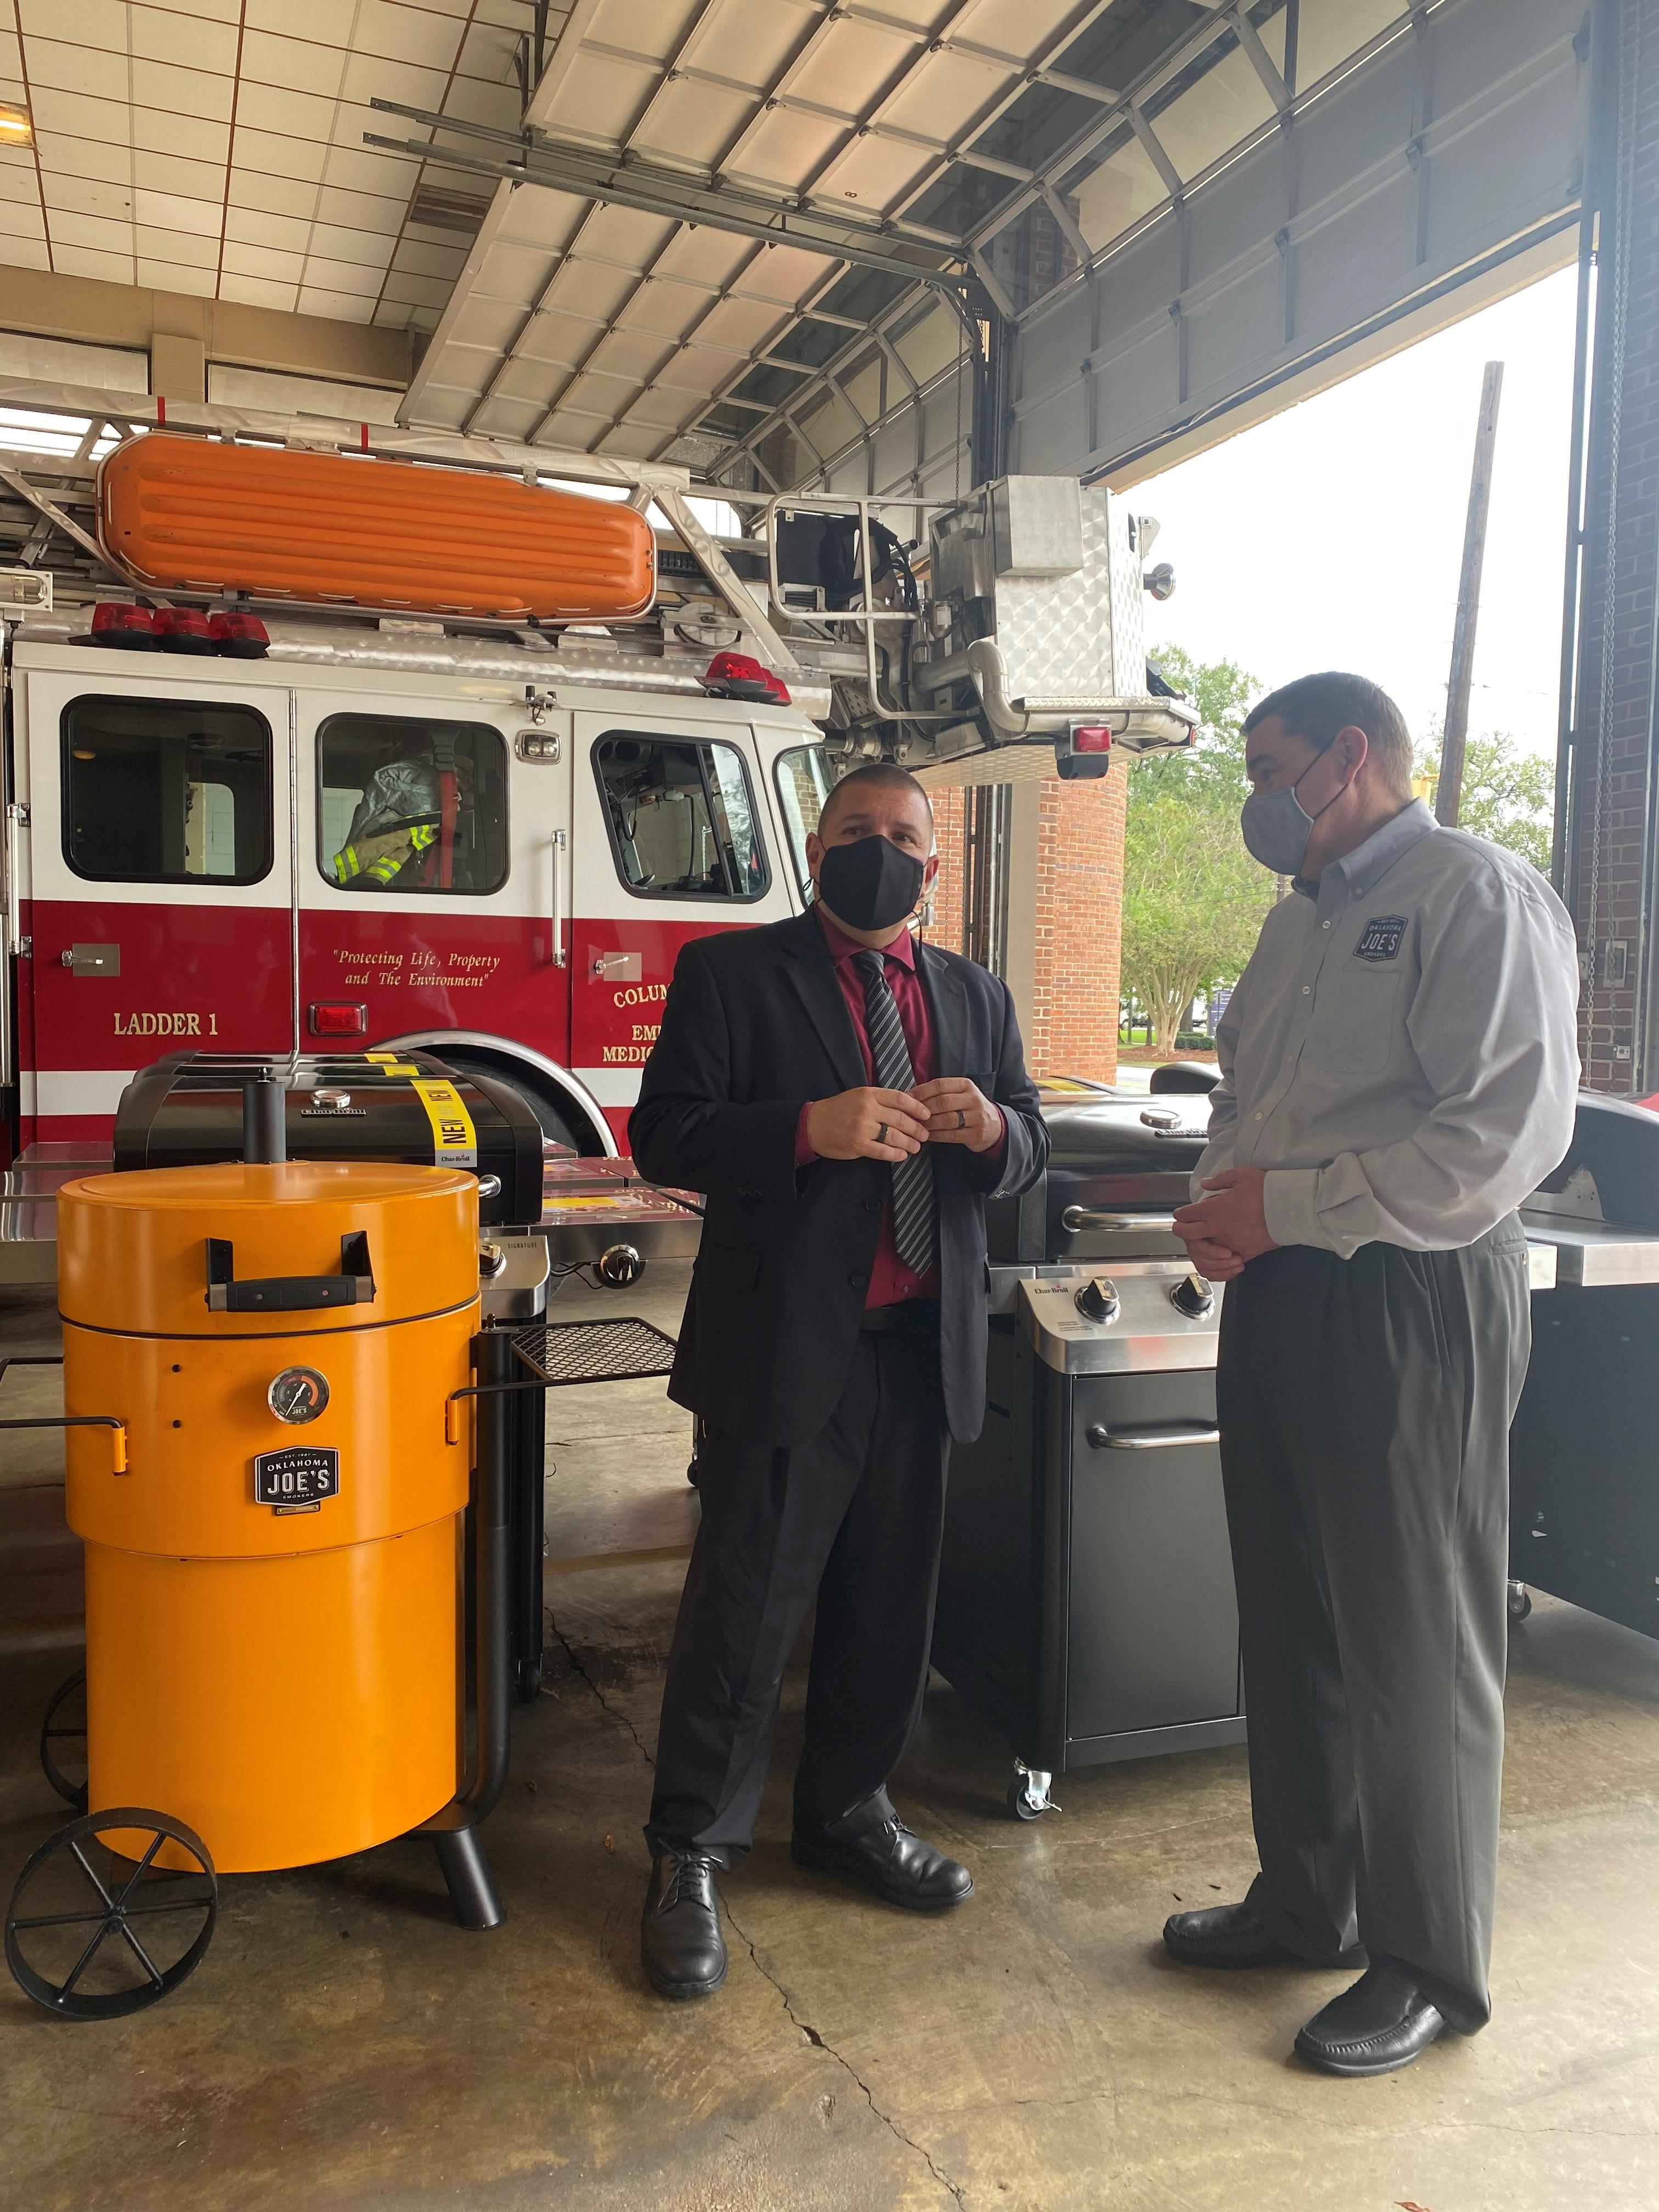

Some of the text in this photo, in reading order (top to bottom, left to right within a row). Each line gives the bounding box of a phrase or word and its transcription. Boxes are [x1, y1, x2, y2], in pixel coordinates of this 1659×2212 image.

[1361, 933, 1398, 951] JOE'S
[334, 949, 500, 973] "Protecting Life, Property
[345, 970, 489, 987] and The Environment"
[114, 1013, 218, 1035] LADDER 1
[426, 1090, 454, 1102] NEW
[439, 1119, 467, 1144] NEW
[1035, 1285, 1069, 1294] Char-Broil
[267, 1459, 329, 1471] OKLAHOMA
[267, 1469, 330, 1496] JOE'S
